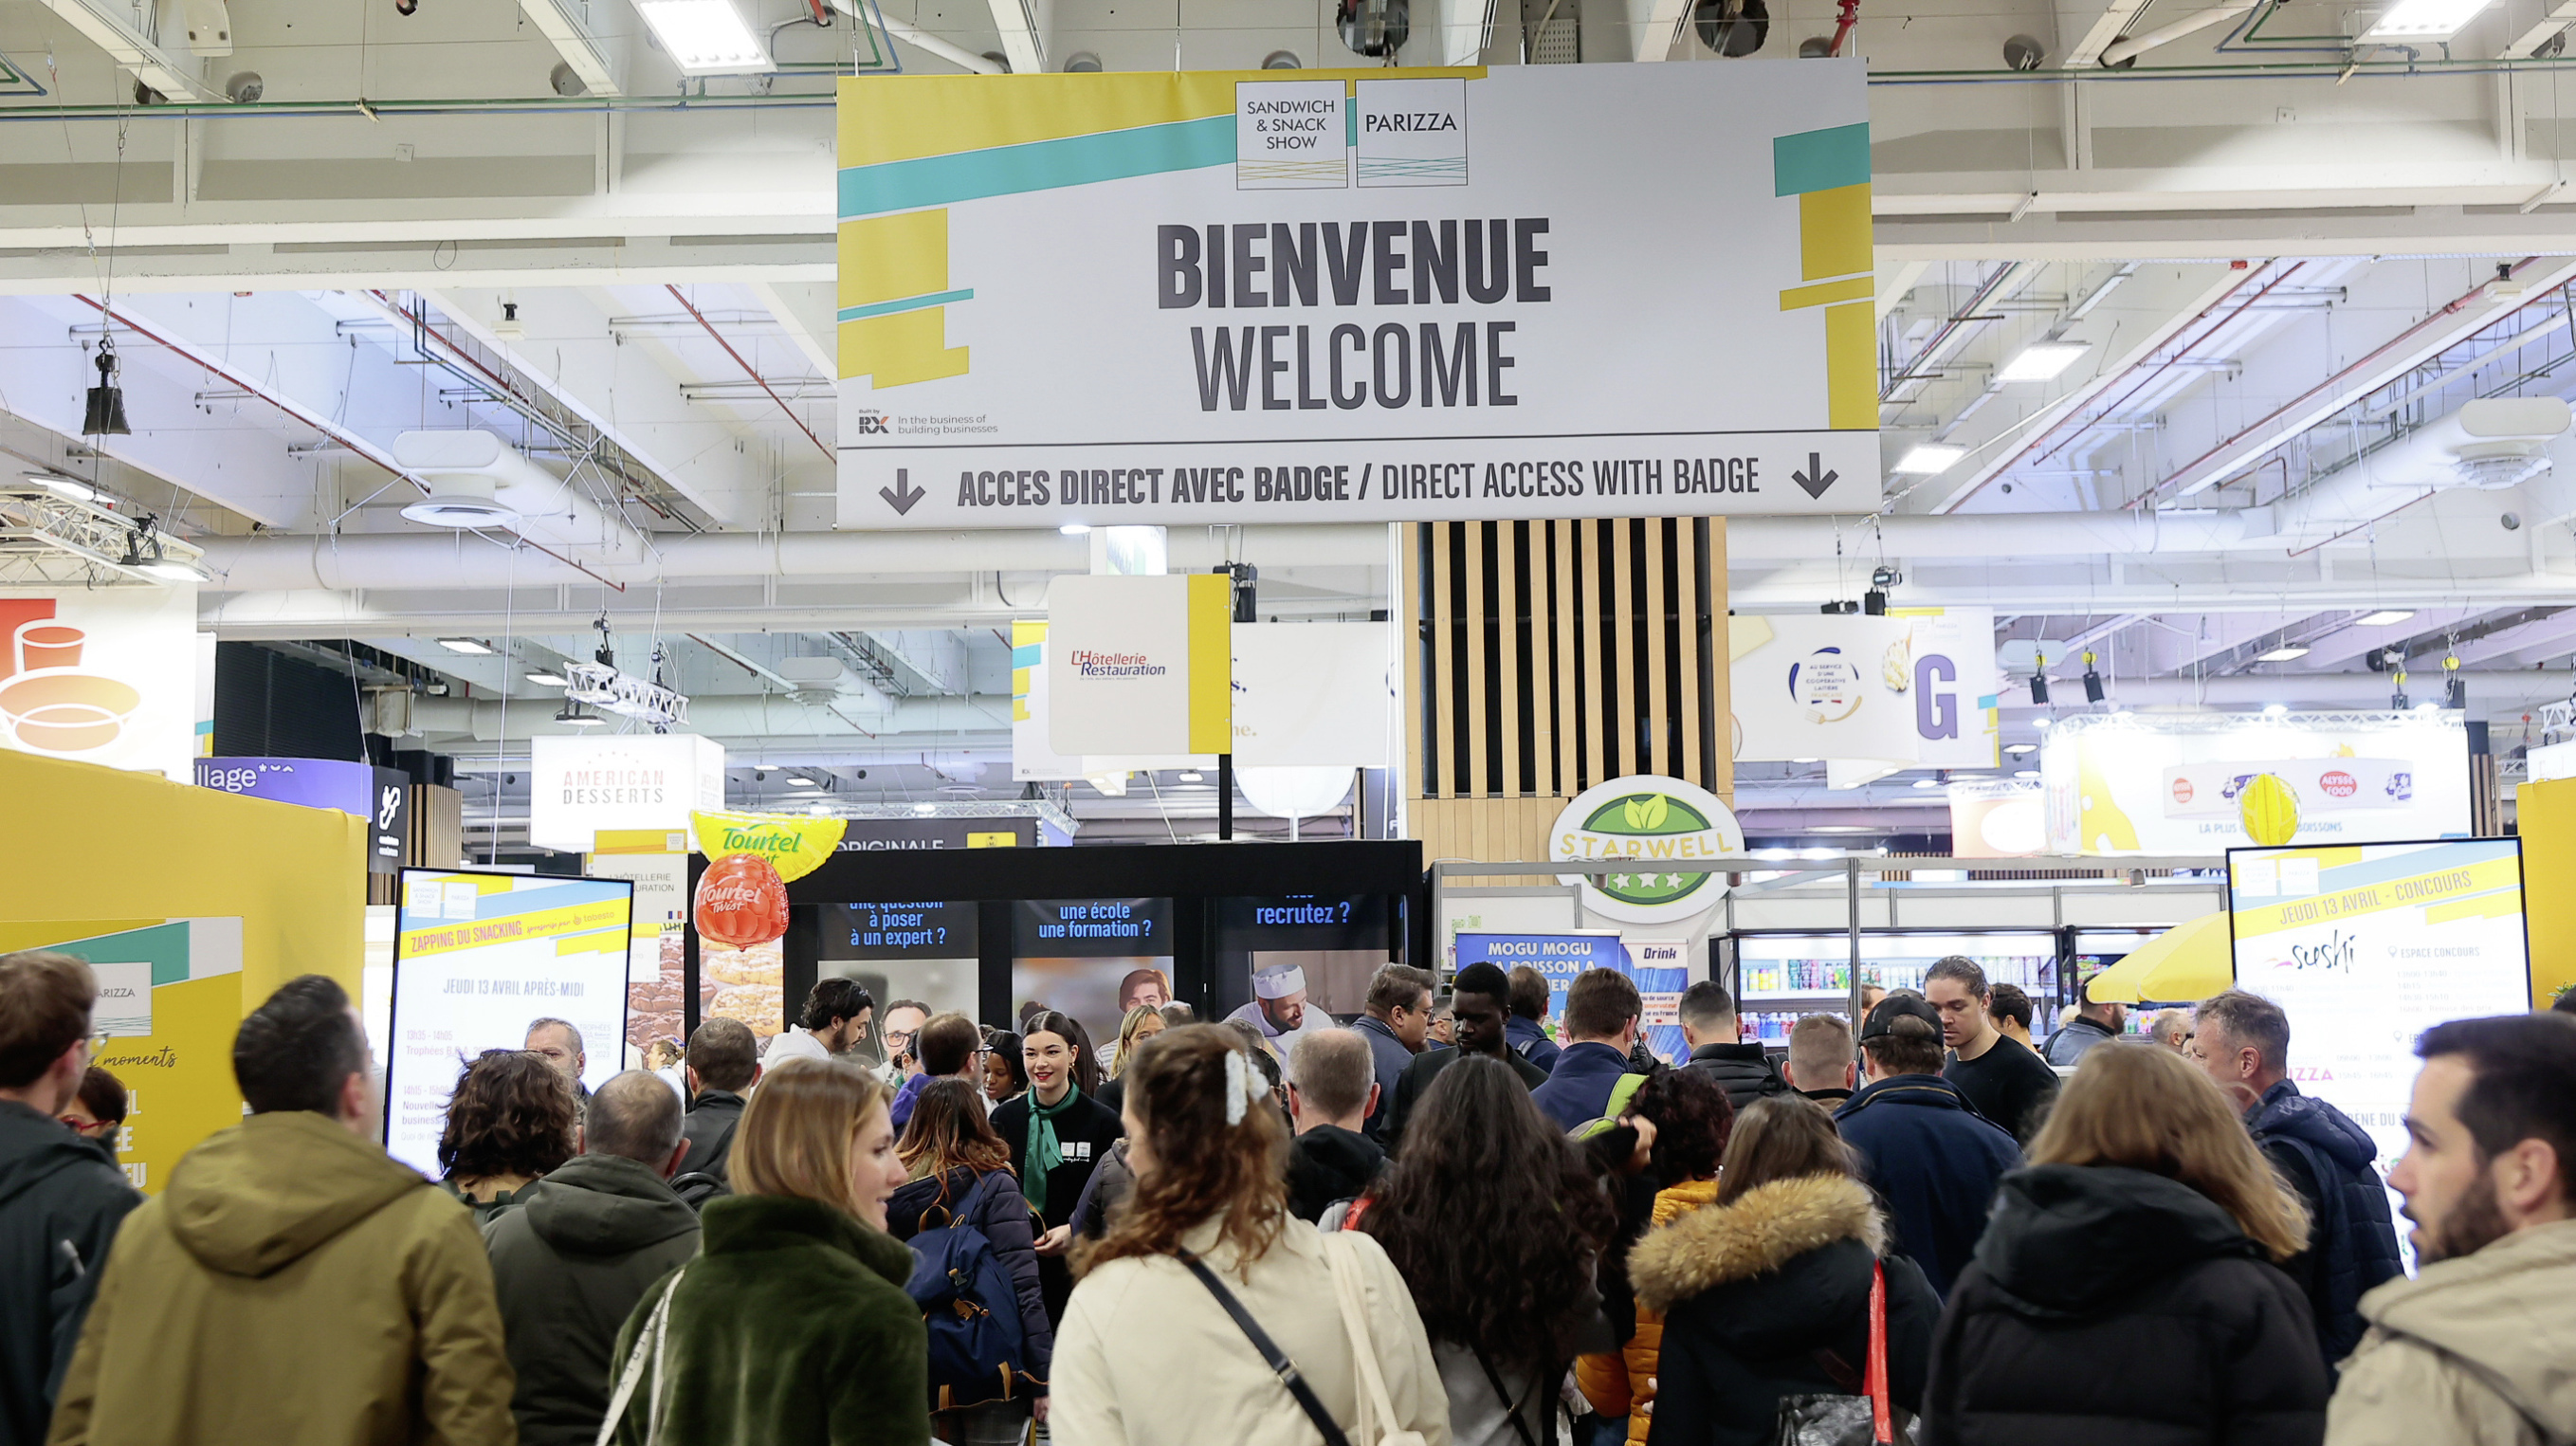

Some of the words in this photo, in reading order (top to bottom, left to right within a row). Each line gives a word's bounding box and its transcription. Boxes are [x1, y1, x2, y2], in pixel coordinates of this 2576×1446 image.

[1247, 100, 1335, 115] SANDWICH
[1256, 119, 1268, 132] &
[1272, 118, 1326, 132] SNACK
[1365, 113, 1457, 133] PARIZZA
[1267, 136, 1318, 150] SHOW
[1157, 217, 1551, 309] BIENVENUE
[1190, 320, 1518, 412] WELCOME
[858, 415, 890, 434] RX
[898, 415, 912, 425] In
[914, 415, 927, 425] the
[930, 414, 975, 425] business
[976, 414, 987, 424] of
[898, 425, 941, 435] building
[942, 424, 998, 434] businesses
[958, 470, 1050, 506] ACCES
[1060, 468, 1164, 505] DIRECT
[1171, 467, 1244, 503] AVEC
[1254, 465, 1349, 502] BADGE
[1358, 463, 1373, 500] /
[1382, 462, 1475, 500] DIRECT
[1483, 461, 1584, 498] ACCESS
[1593, 459, 1663, 495] WITH
[1674, 457, 1760, 494] BADGE
[1080, 661, 1166, 676] Restauration
[1914, 653, 1958, 740] G
[195, 764, 257, 793] llage
[563, 769, 665, 786] AMERICAN
[562, 788, 665, 805] DESSERTS
[2326, 786, 2354, 796] FOOD
[2199, 823, 2210, 833] LA
[2214, 823, 2238, 833] PLUS
[722, 824, 802, 853] Tourtel
[1560, 833, 1733, 859] STARWELL
[702, 881, 764, 906] Tourtel
[2279, 902, 2319, 925] JEUDI
[2322, 897, 2339, 921] 13
[2343, 889, 2382, 918] AVRIL
[2394, 870, 2473, 901] CONCOURS
[710, 900, 746, 914] Twist
[1060, 906, 1087, 920] une
[1090, 901, 1131, 920] école
[1256, 903, 1334, 924] recrutez
[1339, 901, 1350, 924] ?
[869, 910, 878, 927] à
[882, 913, 923, 931] poser
[1038, 924, 1066, 939] une
[1069, 920, 1139, 938] formation
[1142, 919, 1152, 937] ?
[411, 933, 454, 953] ZAPPING
[457, 930, 472, 944] DU
[473, 920, 522, 943] SNACKING
[850, 928, 860, 946] à
[864, 934, 882, 945] un
[886, 928, 933, 949] expert
[937, 926, 946, 944] ?
[1488, 942, 1540, 956] MOGU
[1543, 942, 1593, 956] MOGU
[1643, 947, 1677, 960] Drink
[2292, 928, 2356, 974] sushi
[2401, 948, 2432, 959] ESPACE
[2434, 946, 2480, 958] CONCOURS
[443, 978, 474, 995] JEUDI
[478, 979, 489, 995] 13
[491, 979, 521, 996] AVRIL
[523, 978, 585, 998] APRÈS-MIDI
[406, 1030, 427, 1041] 13h35
[433, 1030, 453, 1041] 14h05
[103, 1045, 178, 1069] moments
[406, 1045, 445, 1057] Trophées
[401, 1114, 441, 1126] business
[2380, 1112, 2395, 1126] DU
